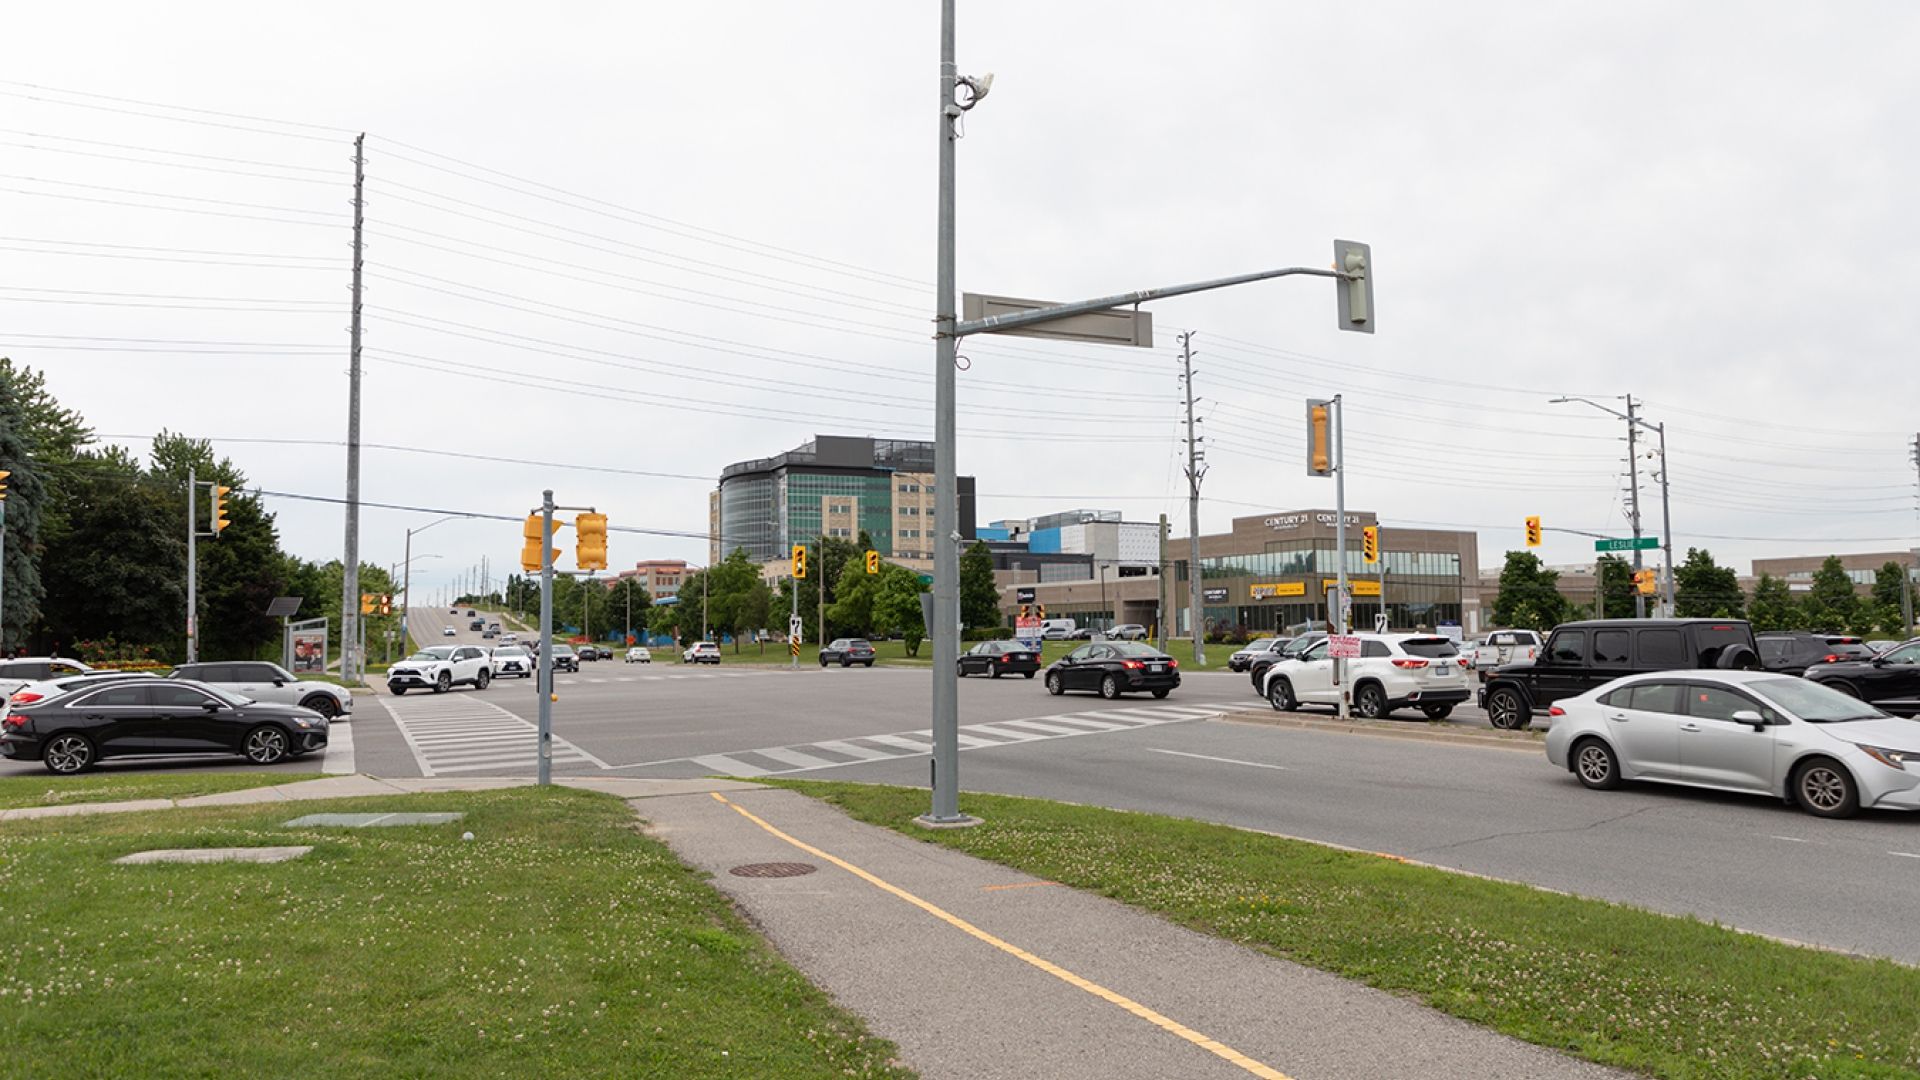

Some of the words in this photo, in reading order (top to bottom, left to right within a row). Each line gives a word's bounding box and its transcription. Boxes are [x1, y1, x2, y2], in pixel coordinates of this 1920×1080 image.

[1264, 514, 1299, 527] CENTURY
[1301, 513, 1308, 523] 21
[1317, 513, 1350, 522] CENTY
[1352, 515, 1359, 523] 21
[1610, 540, 1633, 549] LESLIE
